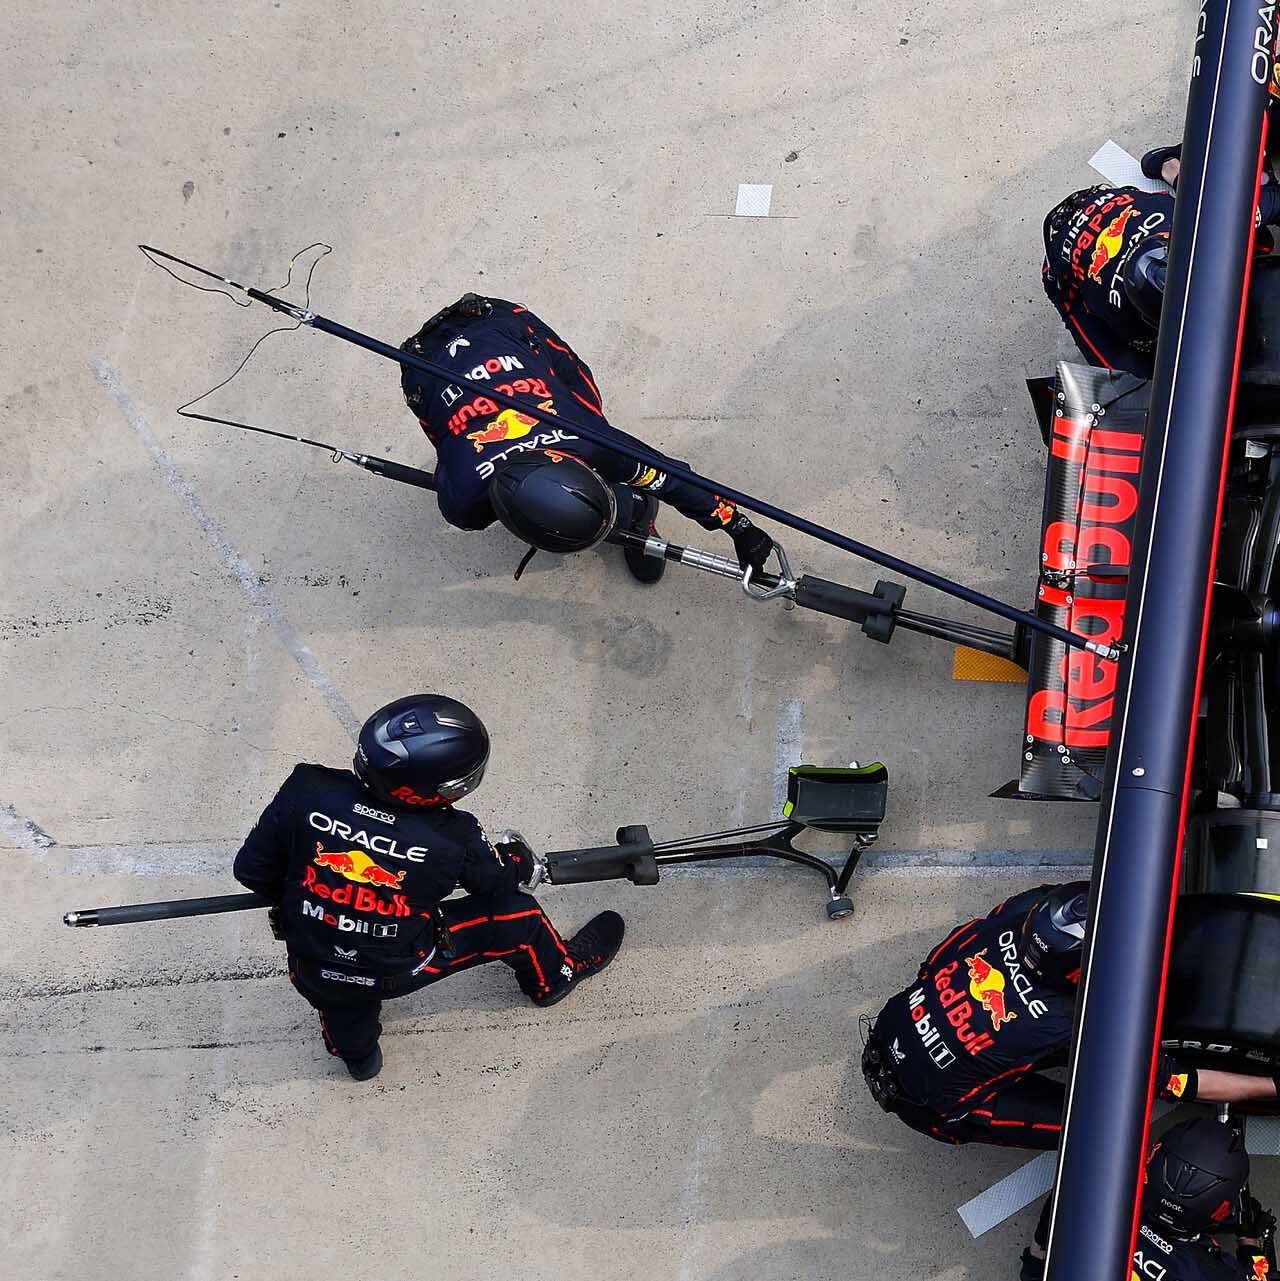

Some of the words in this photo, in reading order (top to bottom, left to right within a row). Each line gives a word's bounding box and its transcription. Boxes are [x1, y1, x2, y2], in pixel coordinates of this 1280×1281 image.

[1251, 0, 1277, 84] ORA
[1068, 193, 1116, 240] Mobil
[1088, 193, 1136, 231] Red
[464, 355, 525, 381] Mob
[1040, 415, 1145, 582] Bull
[1027, 584, 1127, 748] Red
[308, 811, 428, 863] ORACLE
[353, 802, 396, 825] sparco
[302, 865, 352, 906] Red
[354, 889, 412, 918] Bull
[302, 900, 369, 935] Mobil
[934, 960, 971, 1010] Red
[998, 930, 1049, 1019] ORACLE
[908, 987, 942, 1048] Mobil
[946, 999, 997, 1056] Bull
[1160, 1038, 1233, 1053] ERO
[1139, 1225, 1174, 1255] sparco
